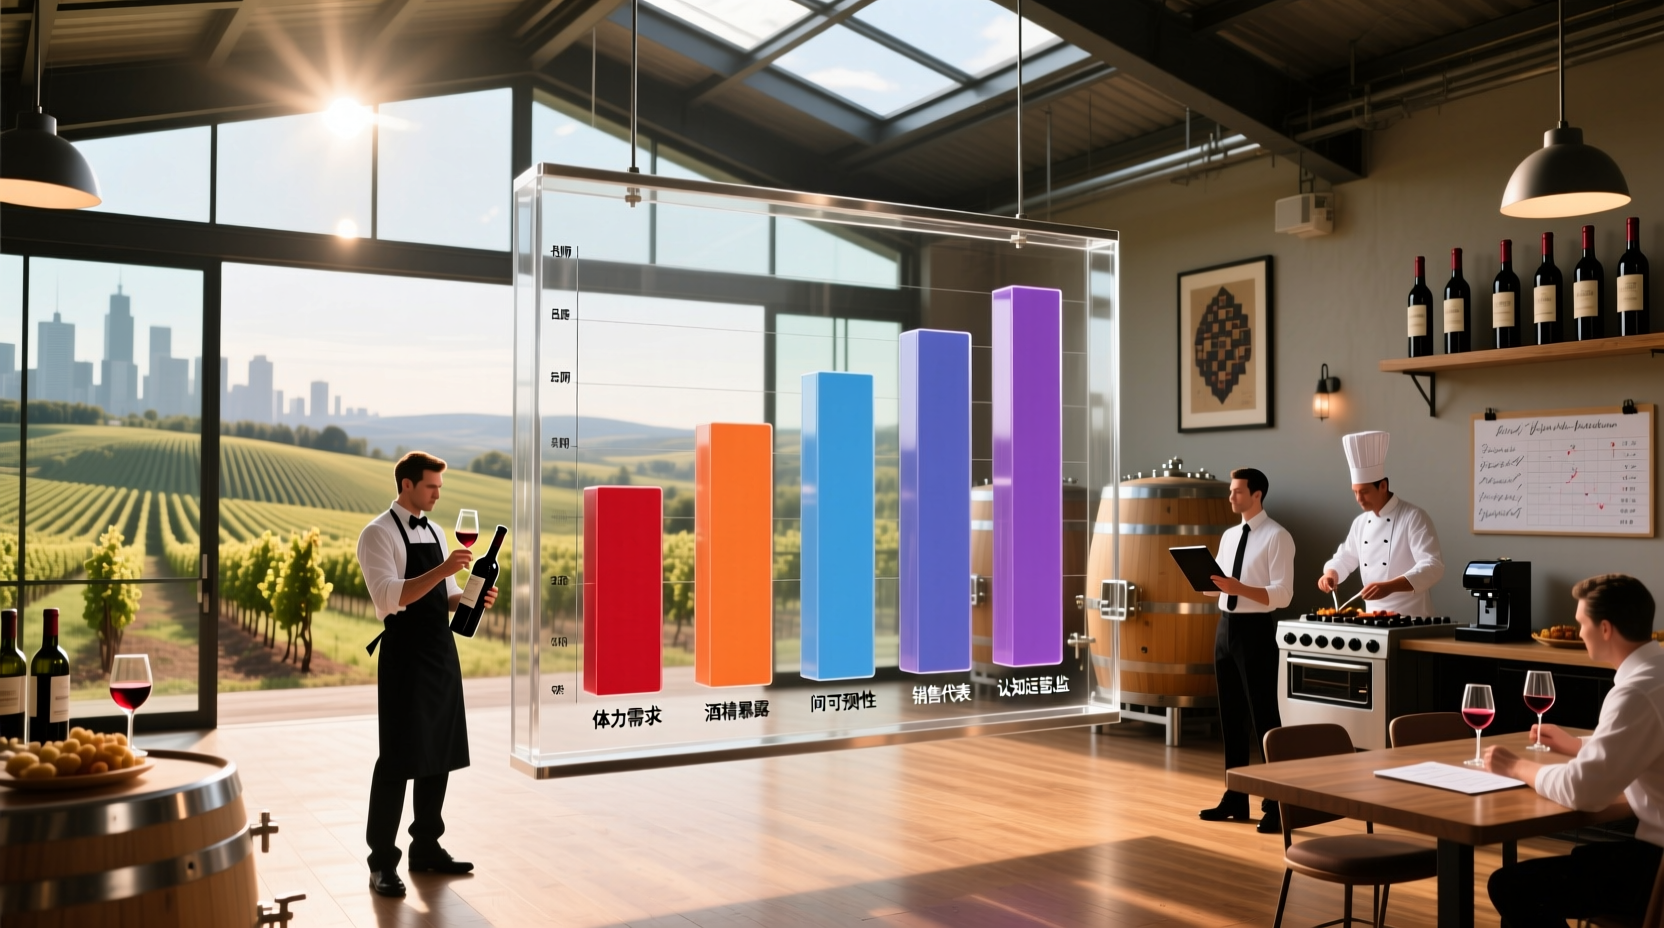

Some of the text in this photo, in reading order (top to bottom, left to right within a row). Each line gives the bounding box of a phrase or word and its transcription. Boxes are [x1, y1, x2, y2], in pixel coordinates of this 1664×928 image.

[912, 682, 972, 705] 销售代表
[592, 704, 663, 730] 体力需求
